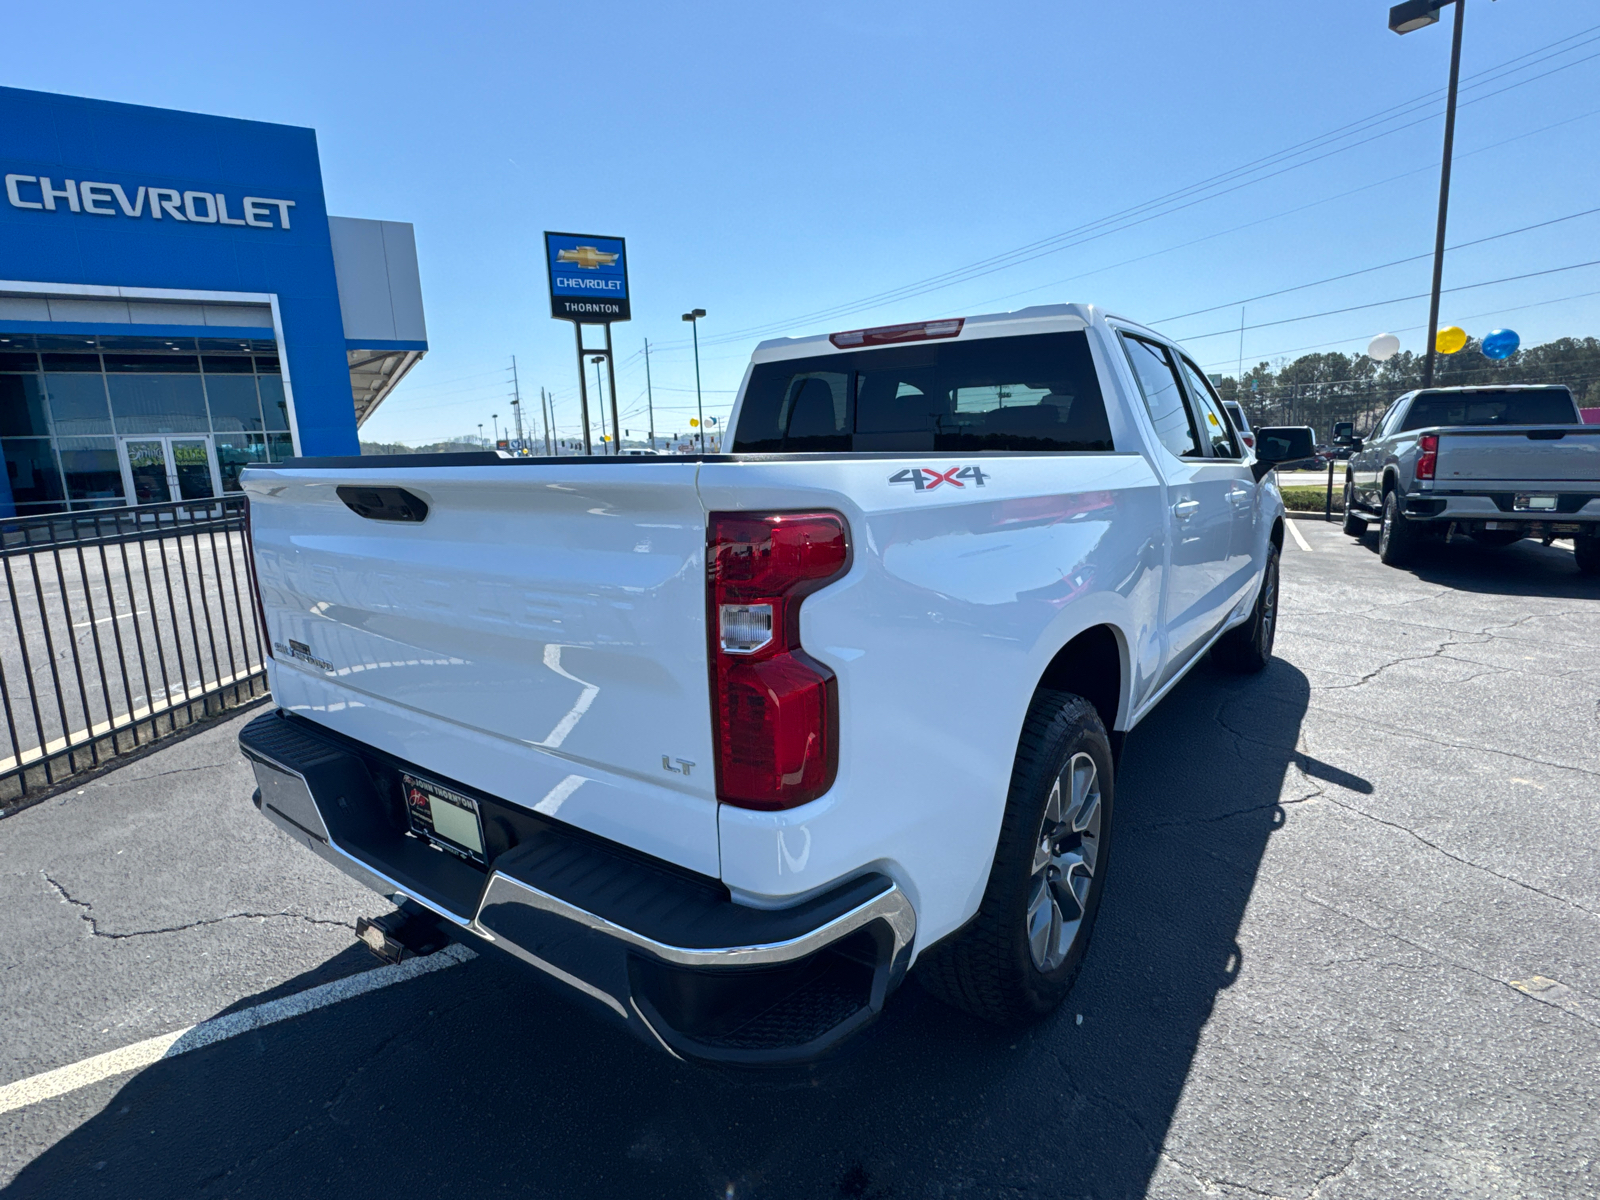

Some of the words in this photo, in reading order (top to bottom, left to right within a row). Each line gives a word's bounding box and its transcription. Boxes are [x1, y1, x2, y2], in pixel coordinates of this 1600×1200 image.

[5, 173, 296, 230] CHEVROLET
[556, 277, 621, 290] CHEVROLET
[564, 302, 619, 313] THORNTON
[886, 465, 991, 492] 4X4
[661, 754, 696, 776] LT
[415, 778, 433, 793] JOHN
[433, 786, 473, 810] THORNTON
